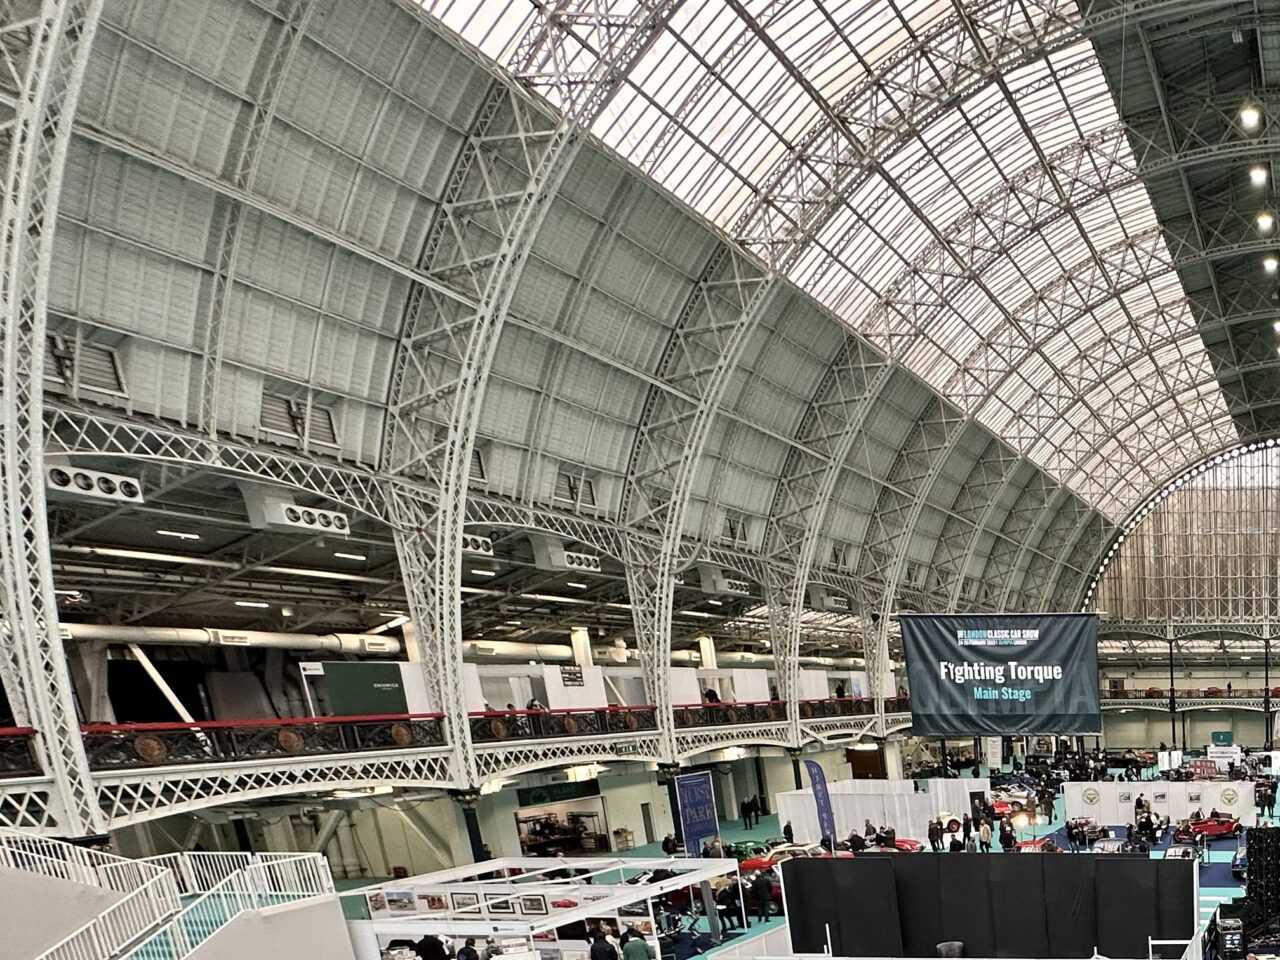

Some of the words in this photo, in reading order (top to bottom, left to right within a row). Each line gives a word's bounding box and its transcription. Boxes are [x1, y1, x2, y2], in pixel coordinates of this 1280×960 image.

[987, 629, 1010, 639] CLASSIC
[1010, 629, 1021, 639] CAR
[1022, 629, 1040, 640] SHOW
[940, 661, 1005, 684] Fighting
[1007, 661, 1063, 684] Torque
[973, 686, 999, 700] Main
[1001, 686, 1032, 702] Stage
